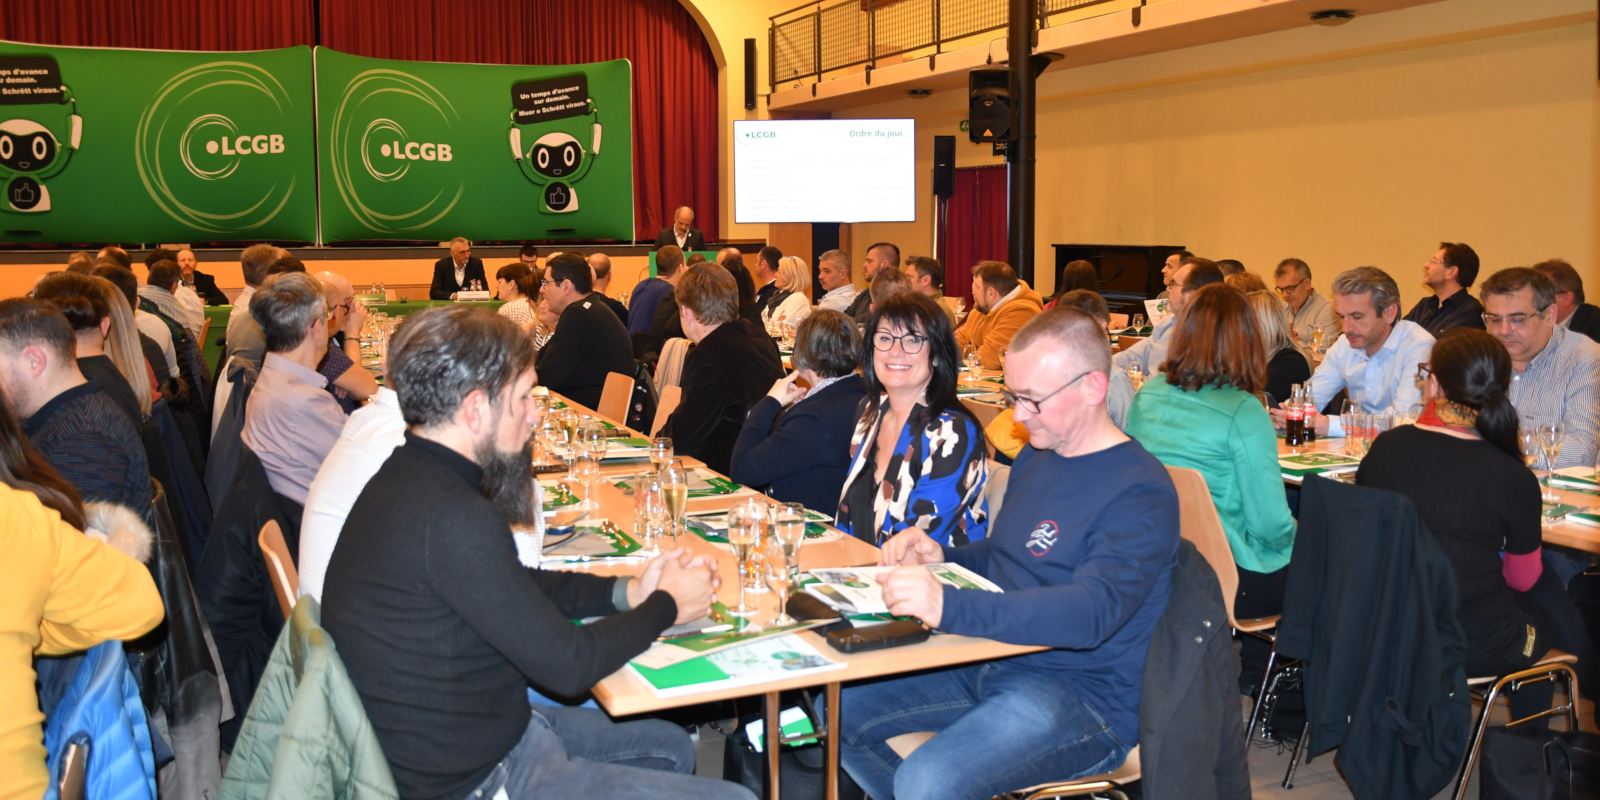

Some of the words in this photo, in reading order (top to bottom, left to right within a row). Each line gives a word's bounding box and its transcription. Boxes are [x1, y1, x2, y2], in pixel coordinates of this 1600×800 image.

[2, 87, 32, 95] Schrëtt
[33, 86, 60, 94] viraus.
[530, 91, 551, 99] temps
[552, 86, 579, 95] d'avance
[545, 94, 570, 103] demain.
[541, 104, 565, 113] Schrëtt
[751, 131, 777, 139] LCGB
[850, 130, 872, 138] Ordre
[887, 130, 903, 139] jour
[221, 134, 285, 156] LCGB
[393, 141, 453, 162] LCGB
